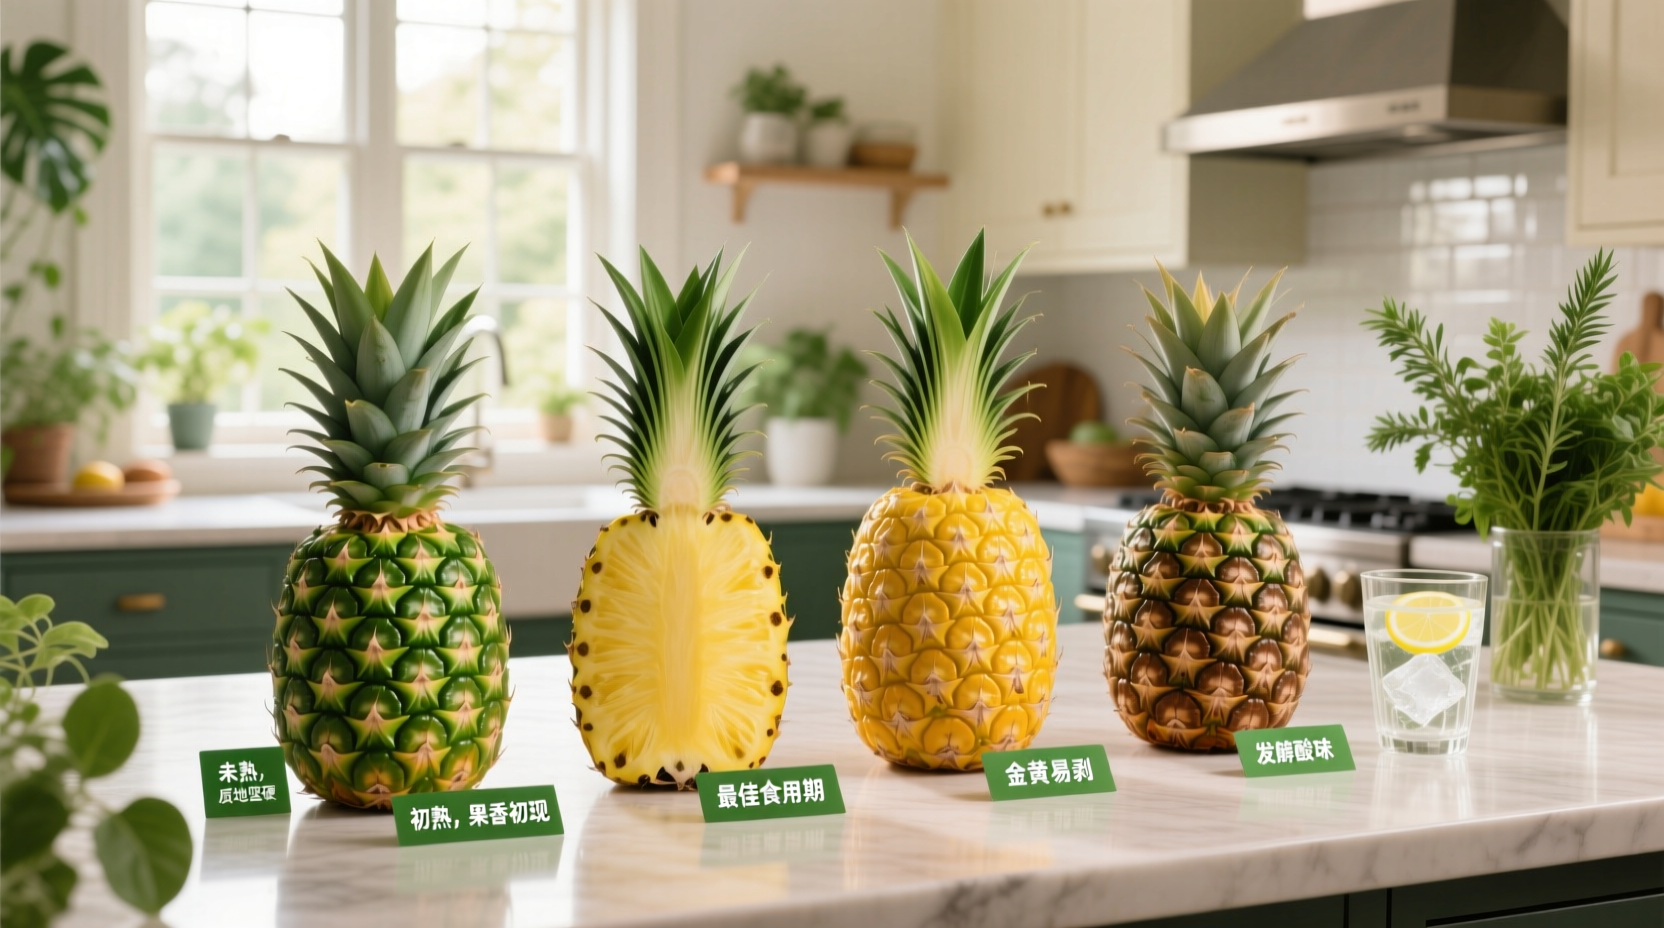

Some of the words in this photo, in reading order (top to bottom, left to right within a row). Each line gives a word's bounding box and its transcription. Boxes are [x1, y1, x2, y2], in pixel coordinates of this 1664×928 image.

[1005, 757, 1095, 787] 金黄易剥
[717, 777, 825, 809] 最佳食用期
[410, 799, 551, 832] 初熟，果香初现
